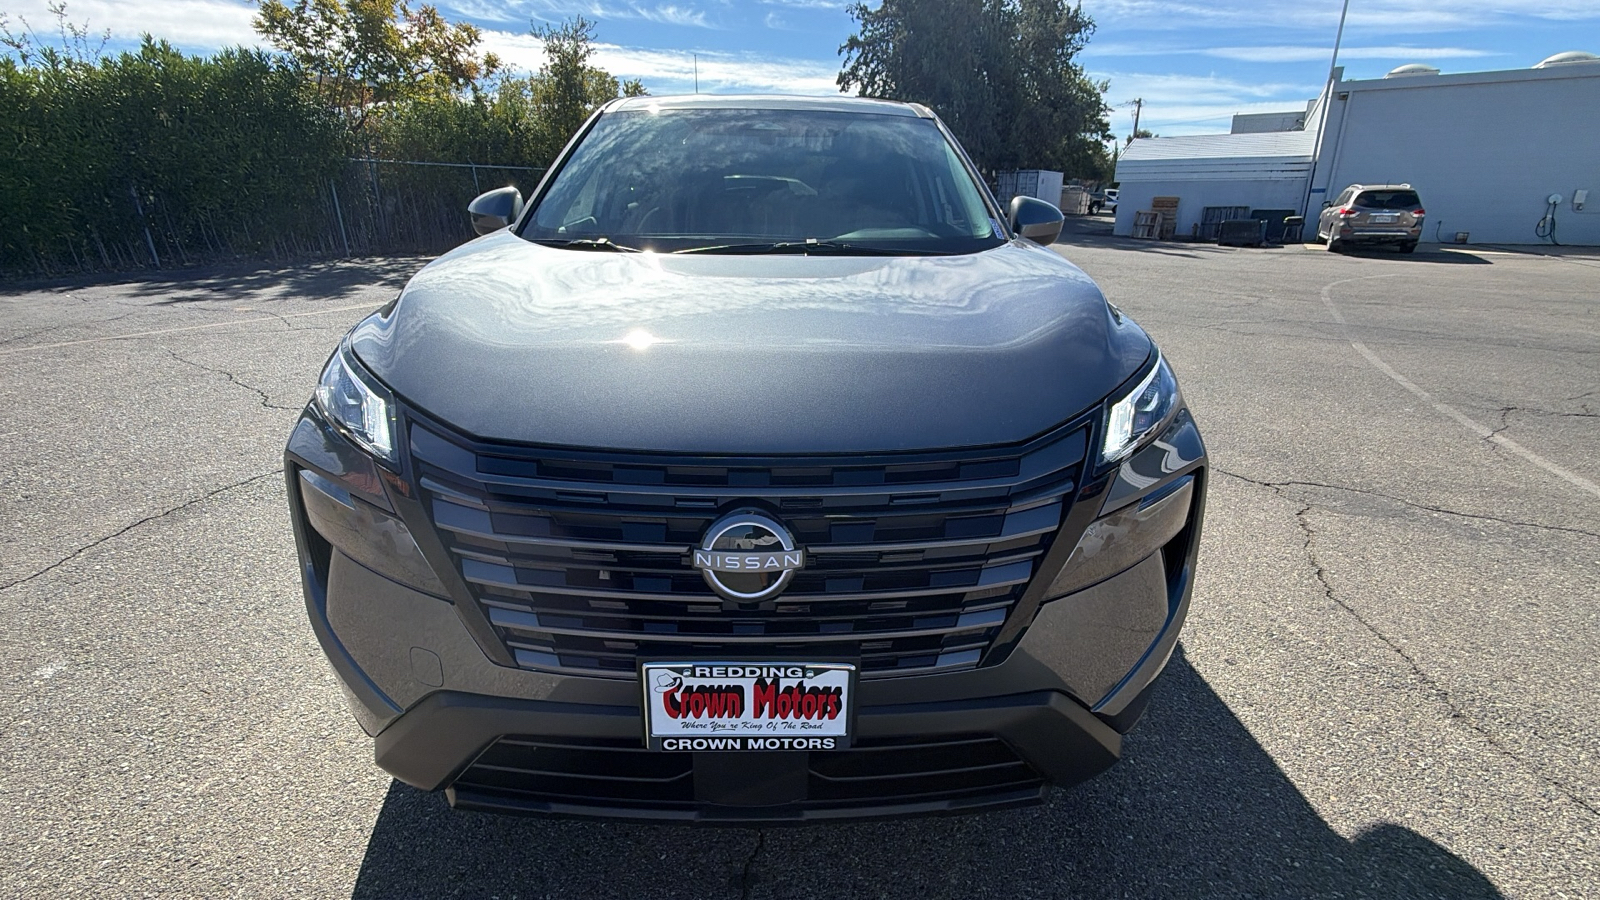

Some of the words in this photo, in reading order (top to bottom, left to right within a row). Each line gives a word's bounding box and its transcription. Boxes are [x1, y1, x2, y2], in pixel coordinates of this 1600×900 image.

[696, 552, 800, 569] NISSAN
[695, 667, 803, 678] REDDING
[663, 683, 744, 719] Crown
[753, 682, 840, 720] Motors
[681, 721, 707, 729] Where
[709, 721, 738, 730] You're
[741, 721, 763, 731] King
[766, 721, 778, 731] Of
[781, 721, 797, 729] The
[799, 722, 824, 730] Road
[663, 738, 741, 750] CROWN
[747, 738, 835, 749] MOTORS
